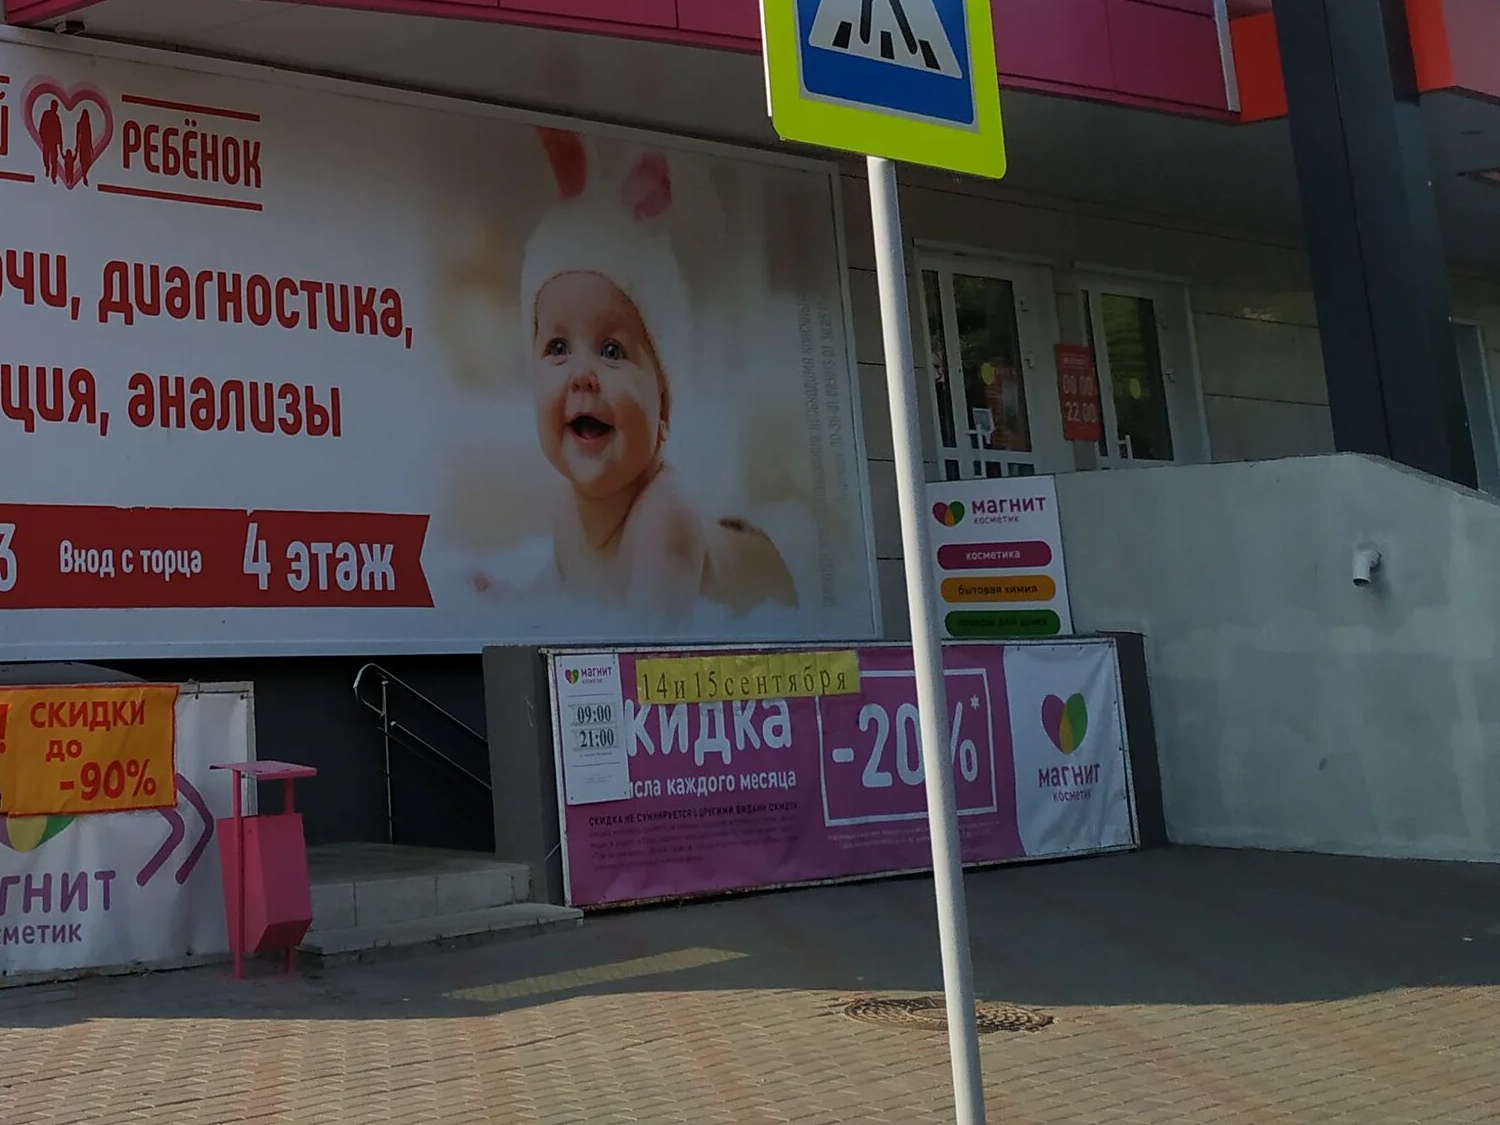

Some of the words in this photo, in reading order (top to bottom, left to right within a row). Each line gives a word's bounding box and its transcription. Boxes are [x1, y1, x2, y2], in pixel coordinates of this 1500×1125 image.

[121, 117, 263, 189] РЕБЁНОК
[97, 258, 414, 351] диагностика,
[127, 370, 342, 439] анализы
[973, 515, 1020, 525] косметик
[58, 539, 115, 579] Вход
[121, 546, 135, 574] с
[141, 546, 203, 580] торца
[242, 521, 271, 591] 4
[285, 537, 397, 593] этаж
[965, 549, 1021, 561] косметика
[957, 583, 1002, 597] бытовая
[1003, 582, 1038, 595] химия
[640, 671, 669, 700] 14
[673, 676, 687, 700] и
[694, 669, 719, 699] 15
[724, 663, 849, 696] сентября
[29, 699, 146, 732] СКИДКИ
[577, 704, 612, 724] 09:00
[624, 698, 793, 766] кидка
[579, 728, 615, 748] 21:00
[59, 758, 157, 801] -90%
[667, 774, 736, 797] каждого
[740, 770, 797, 791] месяца
